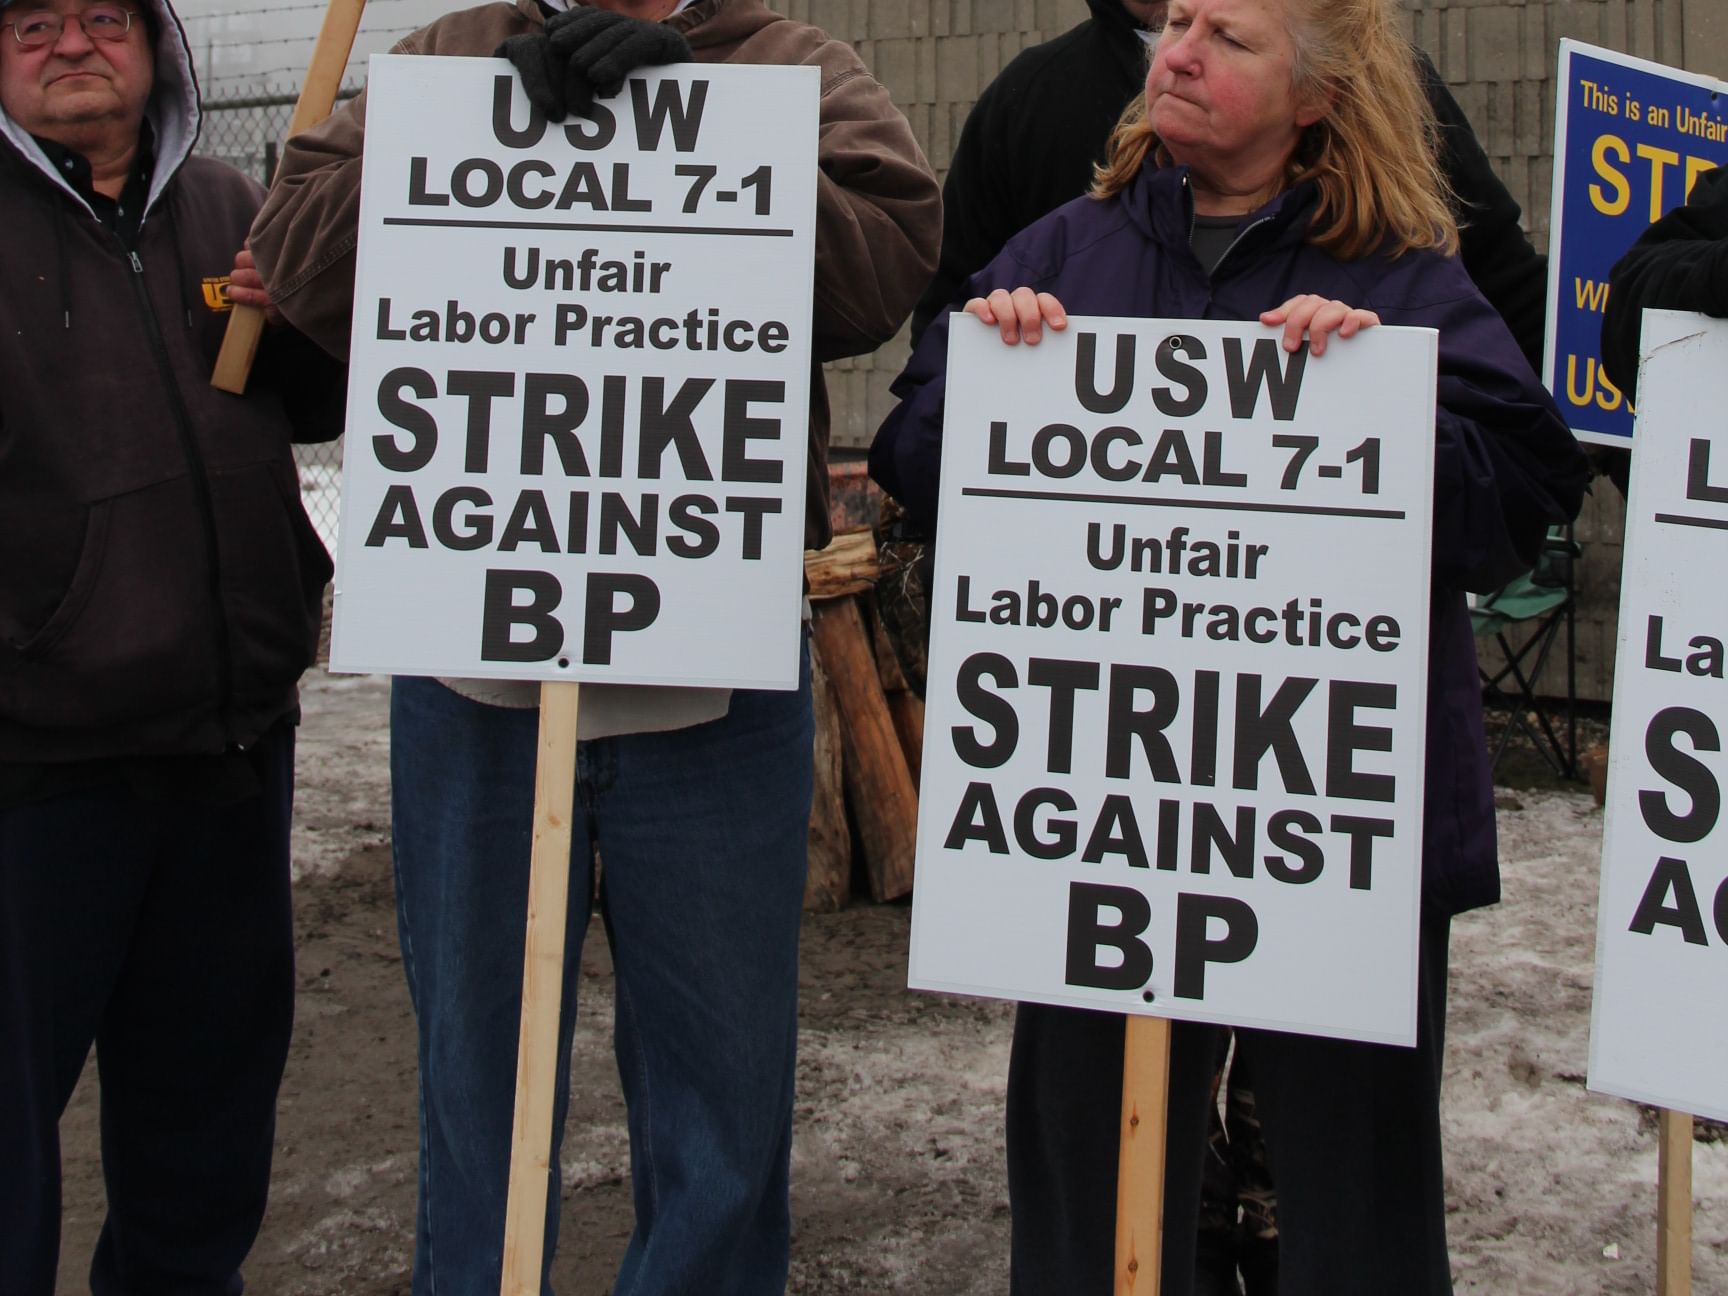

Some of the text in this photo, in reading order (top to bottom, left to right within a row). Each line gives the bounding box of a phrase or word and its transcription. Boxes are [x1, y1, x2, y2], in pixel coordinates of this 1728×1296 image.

[1580, 79, 1728, 142] This is an Unfair
[409, 157, 771, 215] LOCAL 7-1
[504, 247, 671, 293] Unfair
[377, 298, 789, 353] Labor Practice
[1075, 333, 1309, 421] USW
[373, 367, 785, 483] STRIKE
[988, 422, 1380, 494] LOCAL 7-1
[365, 485, 782, 560] AGAINST
[1087, 523, 1269, 579] Unfair
[481, 569, 660, 665] BP
[956, 576, 1400, 652] Labor Practice
[952, 653, 1397, 803] STRIKE
[944, 782, 1394, 890] AGAINST
[1065, 882, 1258, 1000] BP
